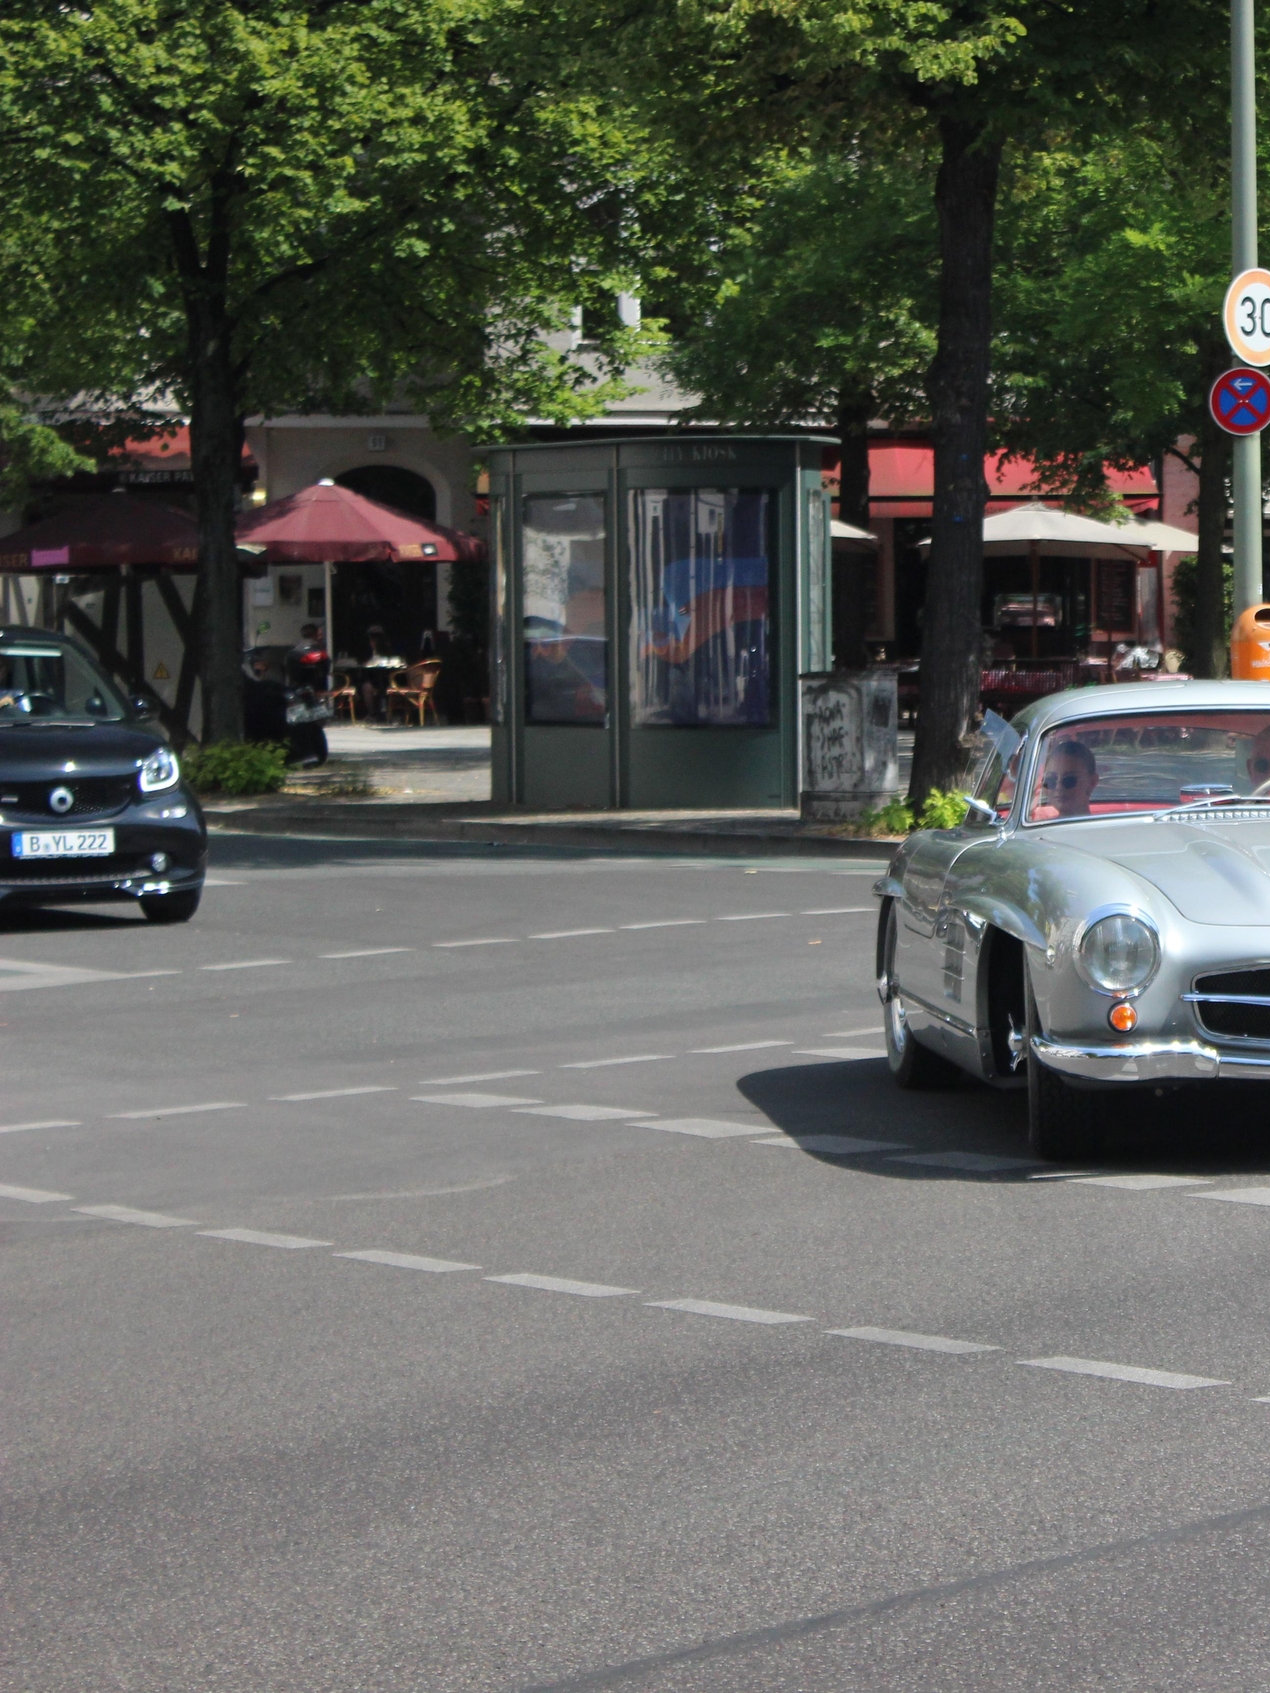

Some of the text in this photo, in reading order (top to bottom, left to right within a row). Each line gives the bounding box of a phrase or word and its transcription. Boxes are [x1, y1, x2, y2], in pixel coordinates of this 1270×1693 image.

[129, 472, 170, 483] KAISER
[30, 833, 107, 853] B YL 222
